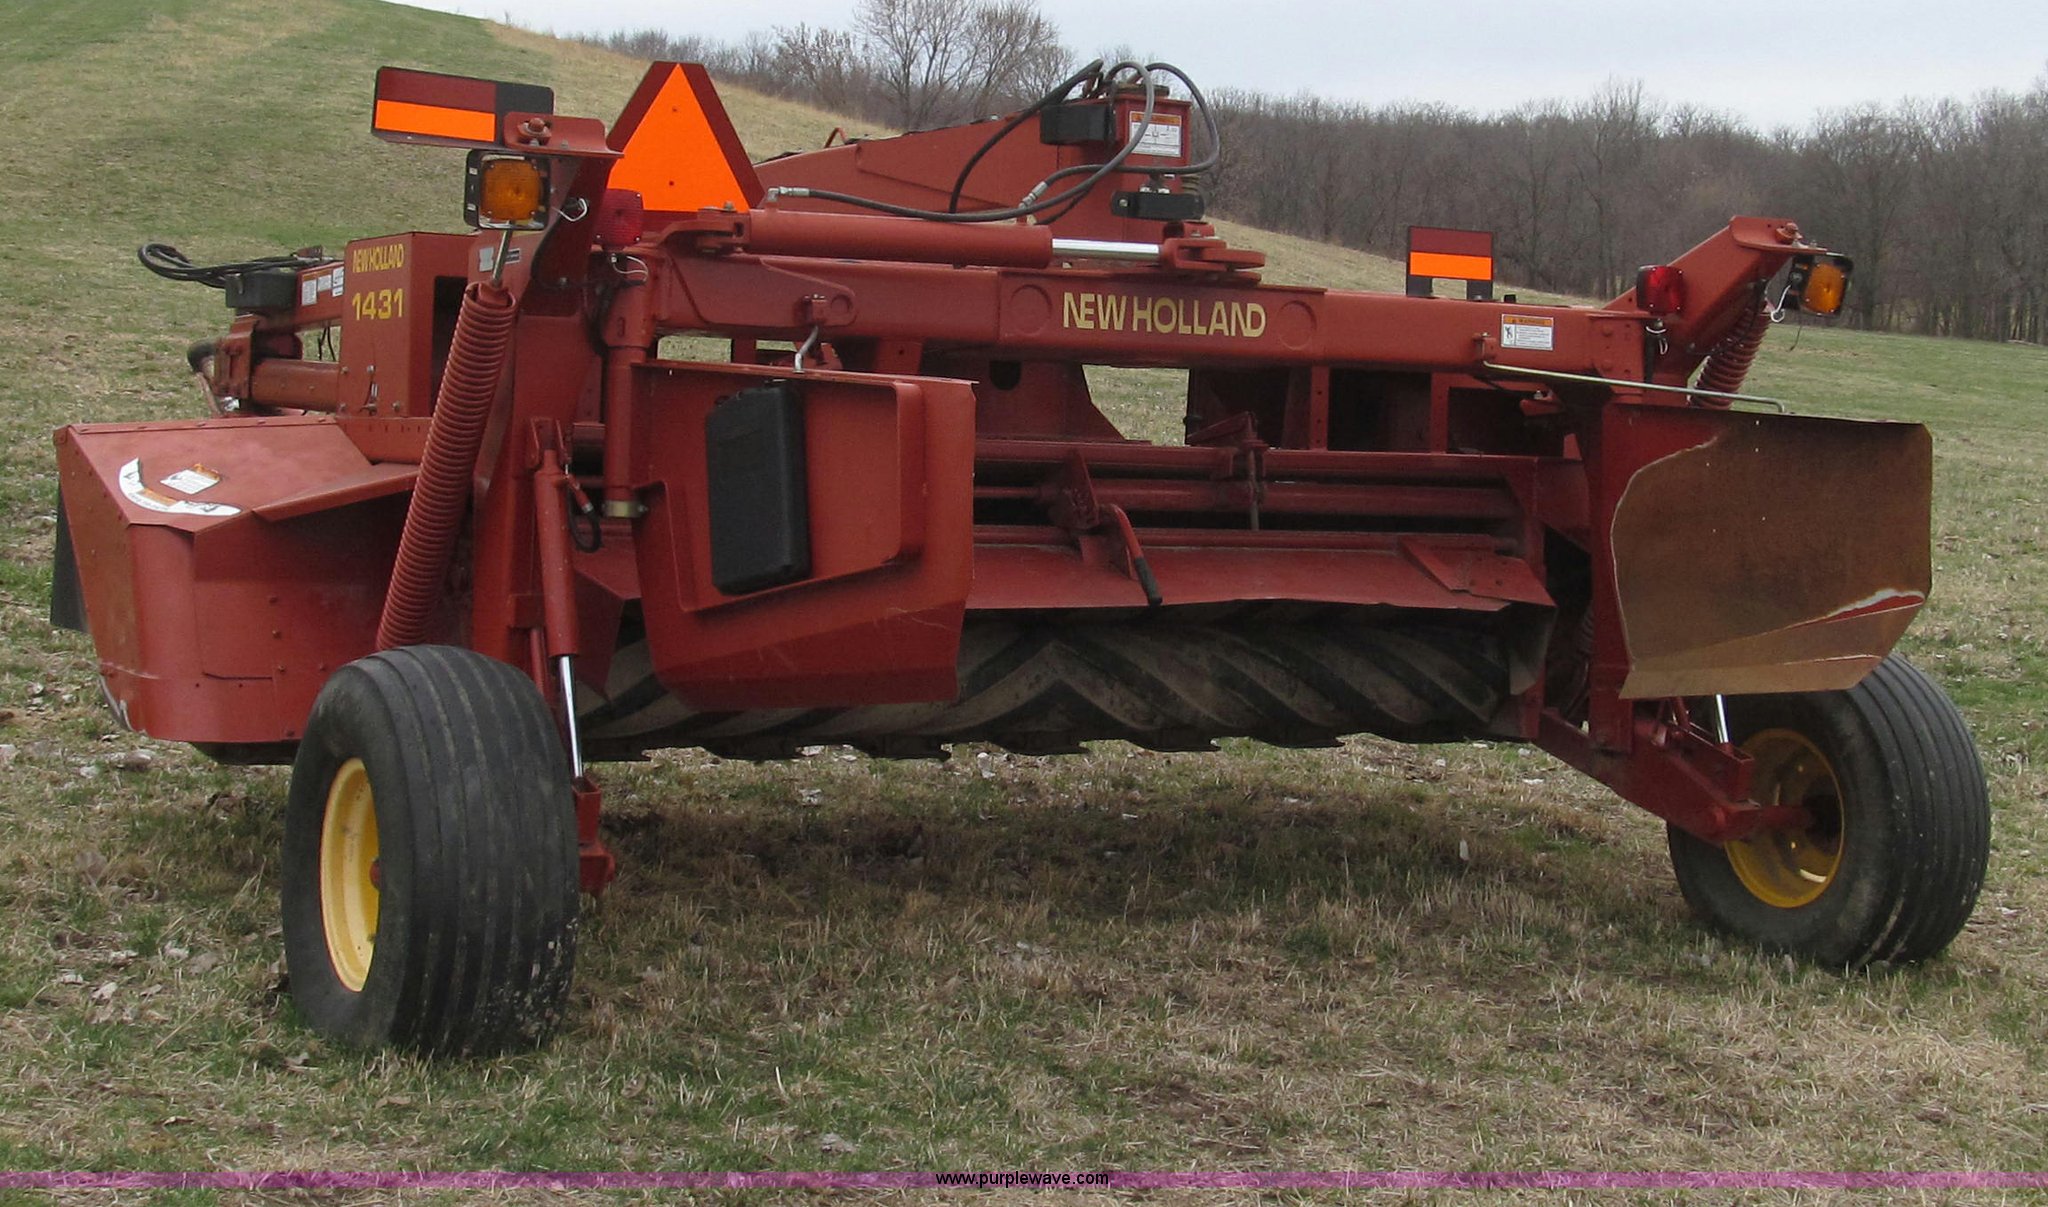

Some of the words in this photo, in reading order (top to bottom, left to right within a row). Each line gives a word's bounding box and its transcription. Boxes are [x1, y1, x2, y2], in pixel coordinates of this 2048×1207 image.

[352, 248, 369, 273] NEW
[369, 243, 404, 272] HOLLAND
[352, 288, 403, 320] 1431
[1063, 292, 1127, 330] NEW
[1132, 296, 1266, 338] HOLLAND
